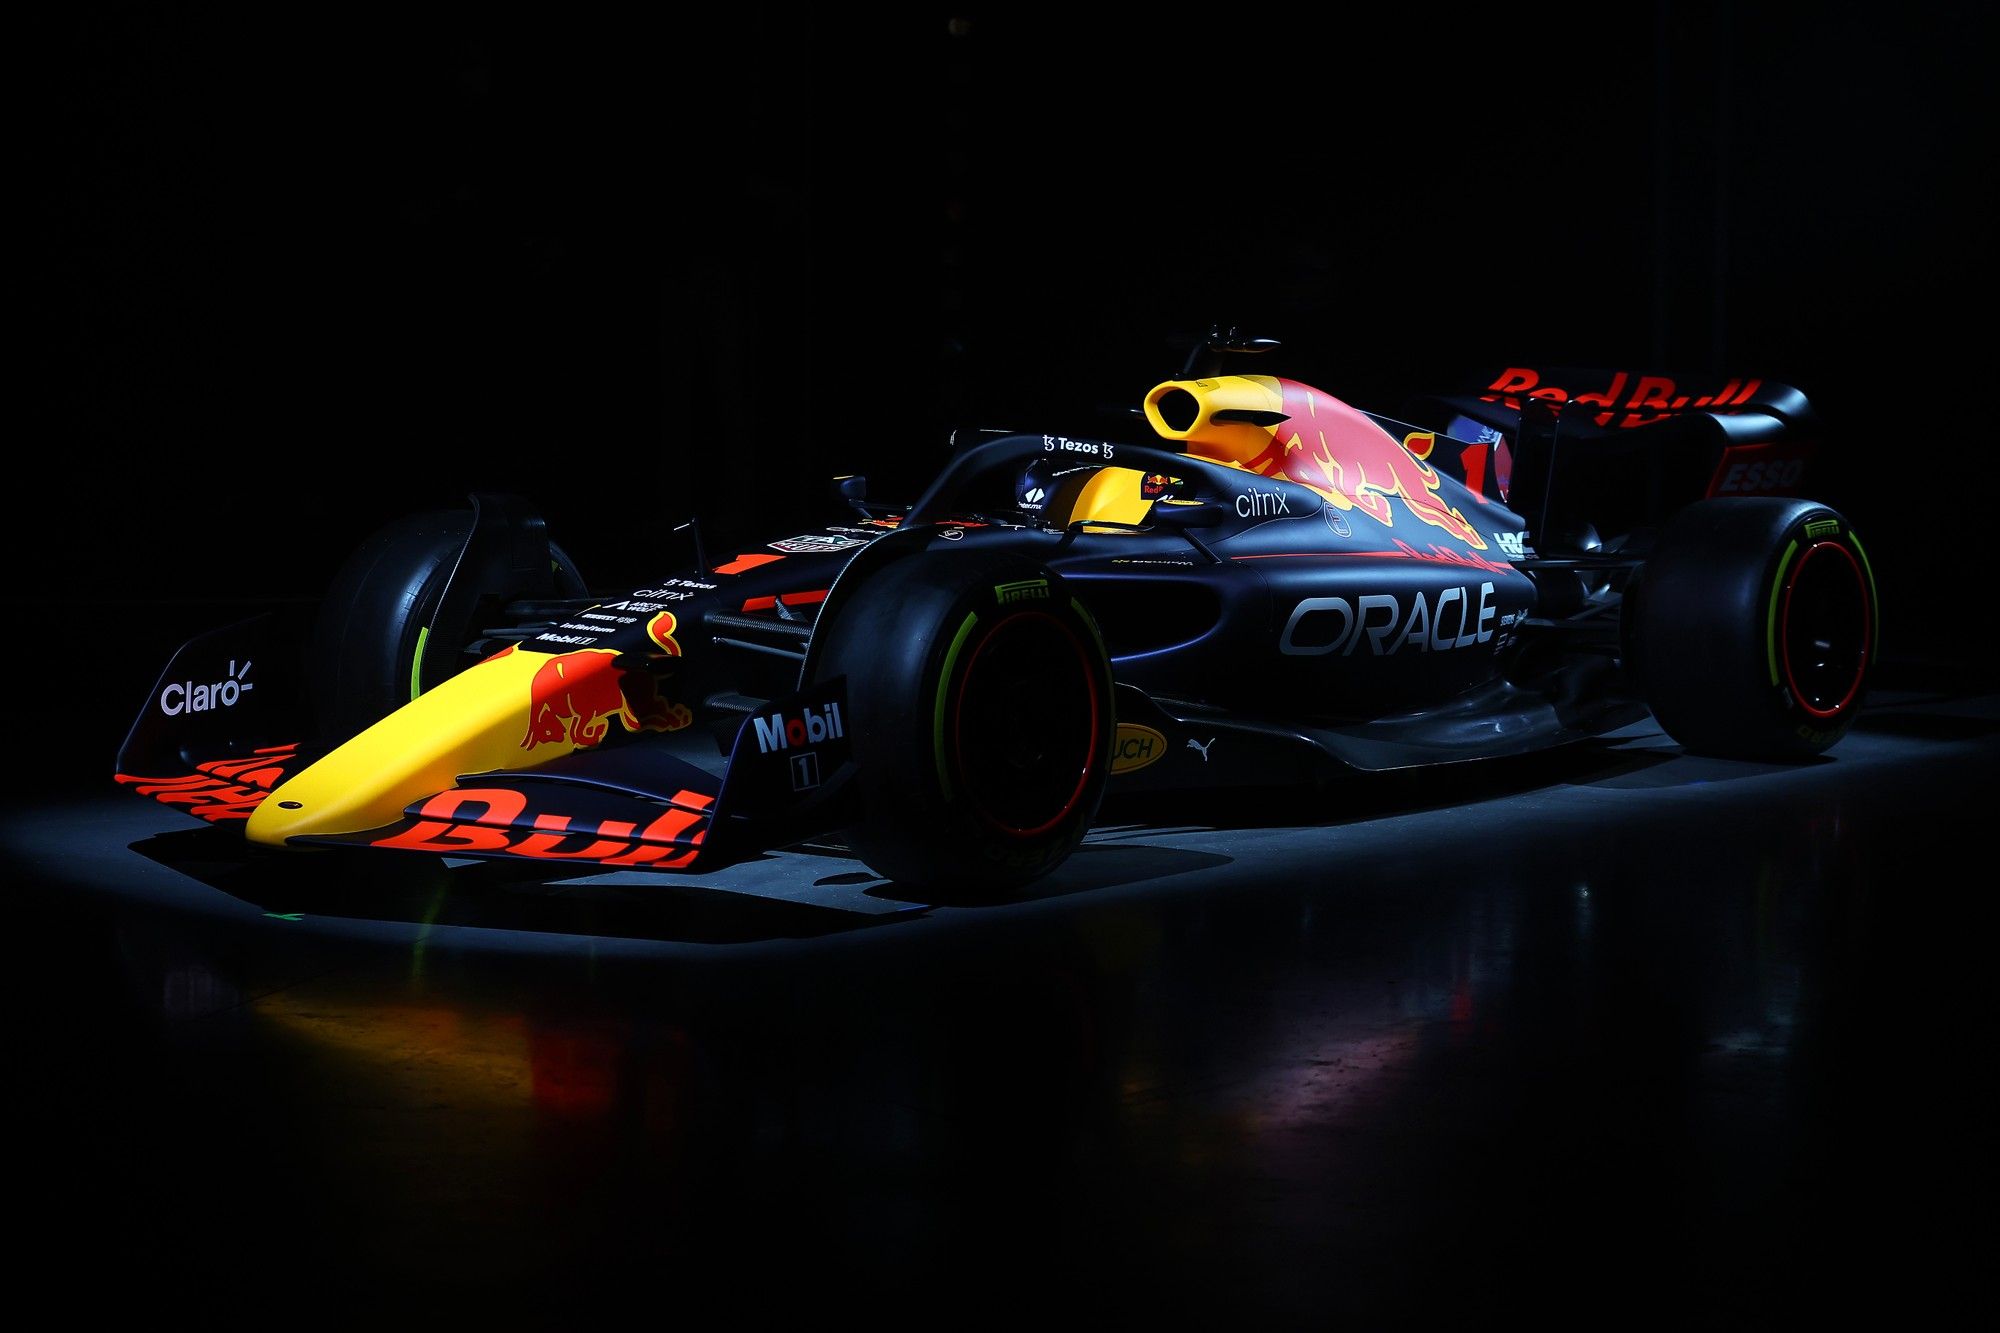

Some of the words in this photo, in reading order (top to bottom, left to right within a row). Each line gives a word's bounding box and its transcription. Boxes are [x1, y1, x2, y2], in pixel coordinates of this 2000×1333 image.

[1058, 437, 1098, 454] Tezos
[1236, 486, 1290, 518] citrix
[994, 579, 1050, 606] PIRELLI
[1279, 581, 1497, 656] ORACLE
[536, 633, 583, 644] Mobil
[161, 672, 244, 716] Claro
[753, 702, 844, 754] Mobil
[1112, 738, 1153, 760] UCH
